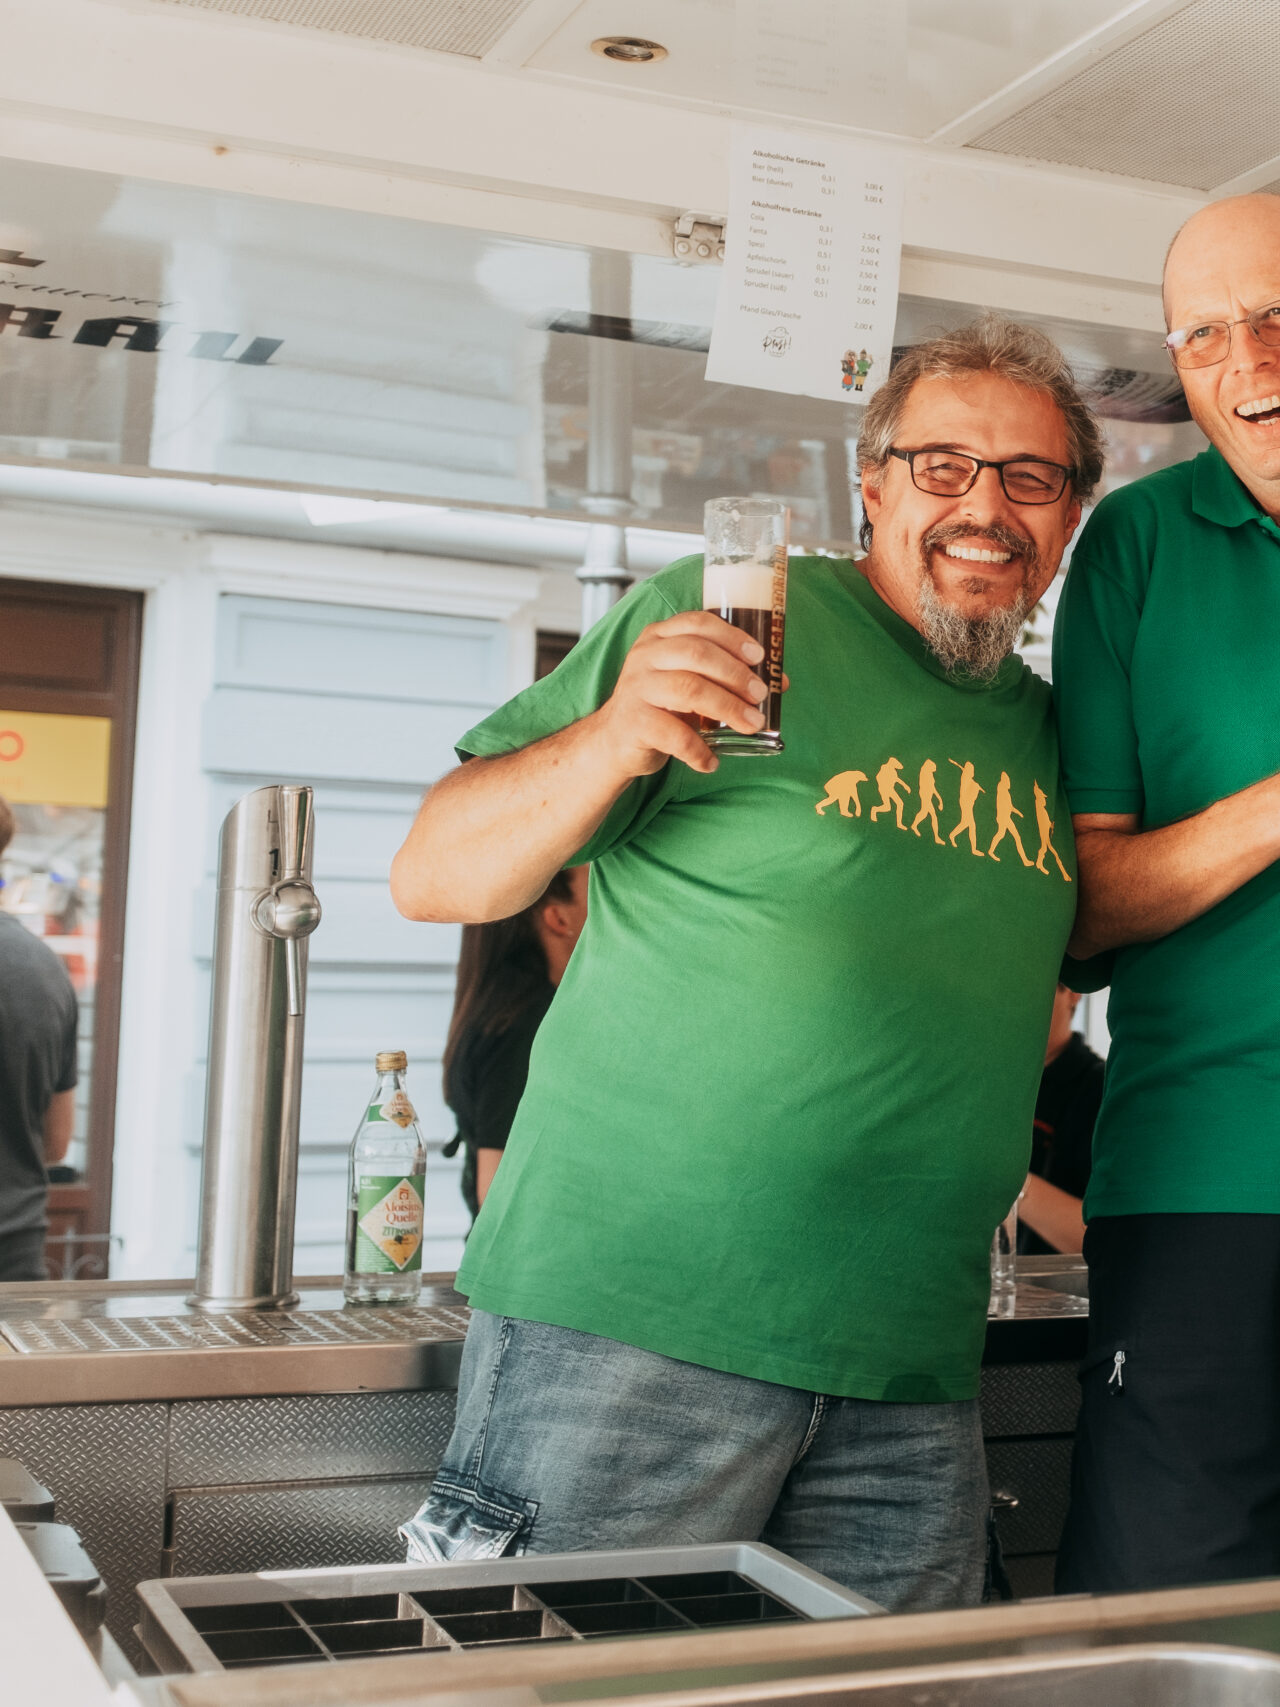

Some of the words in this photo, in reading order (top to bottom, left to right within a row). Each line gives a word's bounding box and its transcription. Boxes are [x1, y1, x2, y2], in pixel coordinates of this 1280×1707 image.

[753, 150, 795, 163] Alkoholische
[796, 157, 826, 168] Getränke
[752, 175, 765, 183] Bier
[821, 187, 832, 195] 0,3
[766, 164, 784, 174] (hell)
[821, 174, 832, 182] 0,3
[751, 200, 791, 212] Alkoholfreie
[792, 207, 823, 218] Getränke
[749, 226, 768, 235] Fanta
[818, 238, 829, 246] 0,3
[860, 245, 875, 254] 2,50
[750, 213, 765, 222] Cola
[819, 225, 830, 233] 0,3
[862, 232, 876, 241] 2,50
[746, 253, 787, 265] Apfelschorle
[816, 264, 827, 272] 0,5
[858, 271, 873, 279] 2,50
[817, 251, 828, 259] 0,5
[859, 258, 874, 267] 2,50
[743, 279, 769, 289] Sprudel
[813, 290, 824, 298] 0,5
[856, 297, 871, 305] 2,00
[745, 266, 771, 276] Sprudel
[771, 269, 795, 280] (sauer)
[815, 277, 825, 285] 0,5
[857, 284, 871, 293] 2,00
[740, 304, 760, 314] Pfand
[760, 307, 802, 320] Glas/Flasche
[854, 322, 868, 330] 2,00
